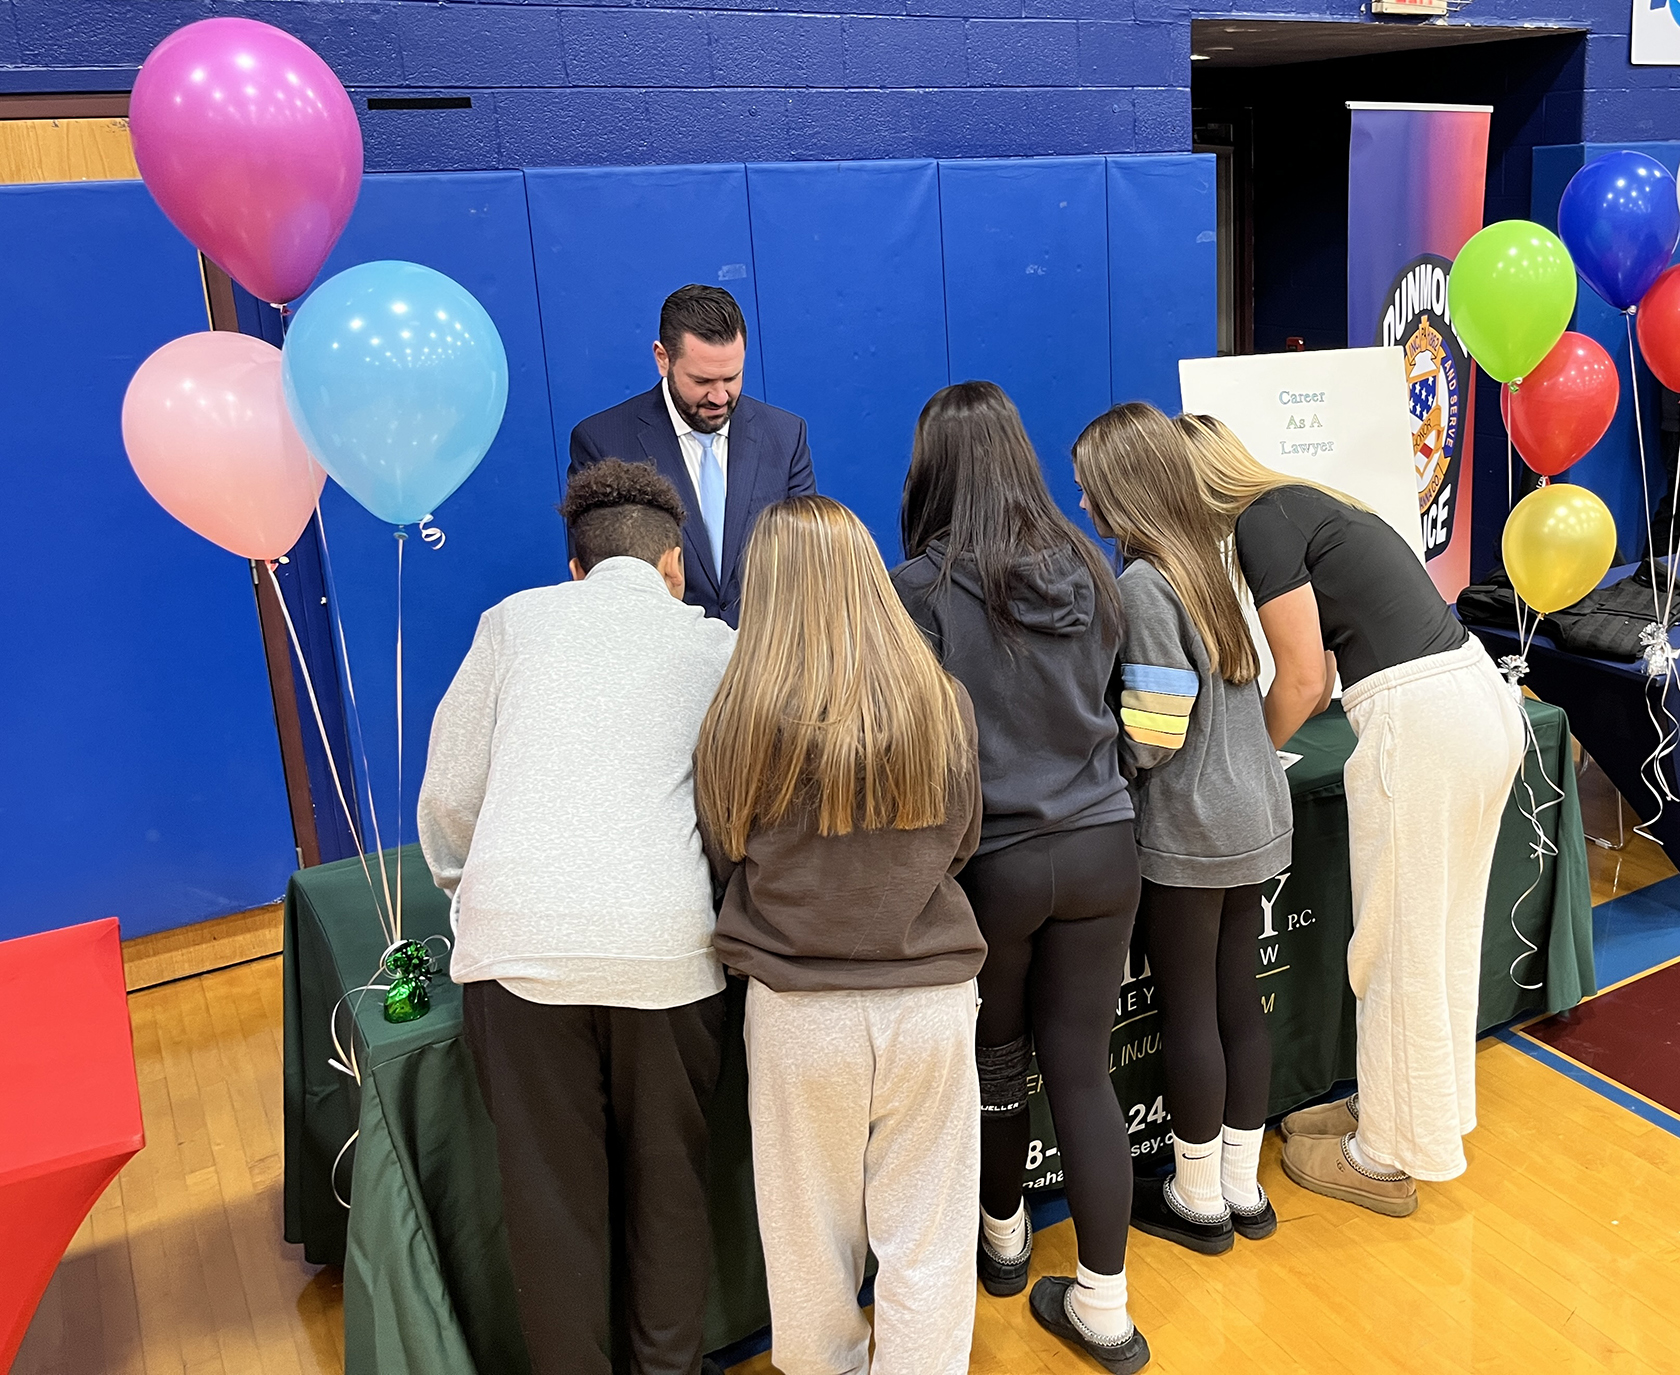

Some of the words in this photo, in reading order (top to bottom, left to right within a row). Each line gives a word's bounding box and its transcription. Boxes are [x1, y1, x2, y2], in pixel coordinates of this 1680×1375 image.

[1444, 360, 1456, 390] AND
[1279, 390, 1326, 405] Career
[1286, 415, 1306, 429] As
[1310, 413, 1323, 428] A
[1446, 395, 1457, 448] SERVE
[1280, 440, 1334, 457] Lawyer
[1423, 483, 1451, 551] ICE
[1287, 909, 1316, 931] P.C.
[1121, 1032, 1162, 1067] INJU
[981, 1102, 1019, 1111] UELLER
